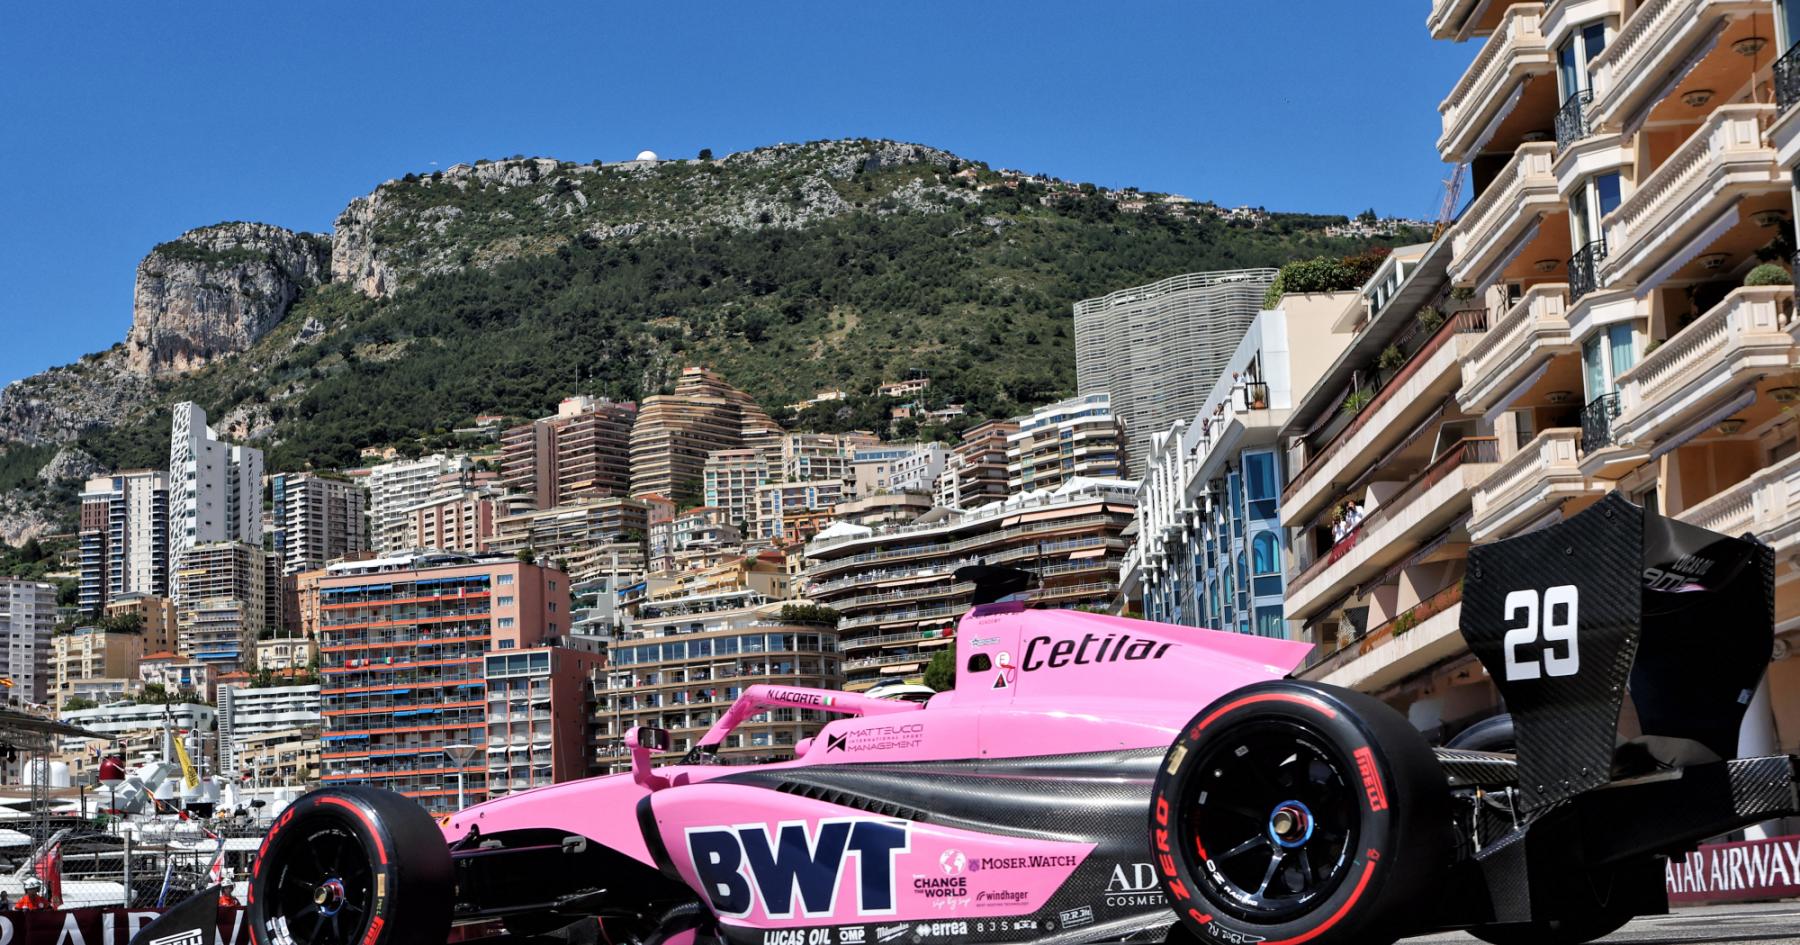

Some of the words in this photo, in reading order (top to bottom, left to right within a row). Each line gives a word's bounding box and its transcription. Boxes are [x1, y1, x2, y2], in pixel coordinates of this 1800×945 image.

[1504, 585, 1580, 681] 29
[1022, 633, 1172, 672] Cetilar
[848, 740, 922, 752] MANAGEMENT
[1353, 747, 1389, 812] PIRELLI
[1156, 797, 1191, 900] ZERO
[685, 817, 911, 919] BWT
[914, 877, 967, 889] CHANGE
[925, 888, 967, 898] WORLD
[986, 890, 1028, 902] windhager
[1106, 895, 1168, 907] COSMET
[763, 929, 805, 945] LUCAS
[808, 928, 831, 945] OIL
[839, 927, 865, 943] OMP
